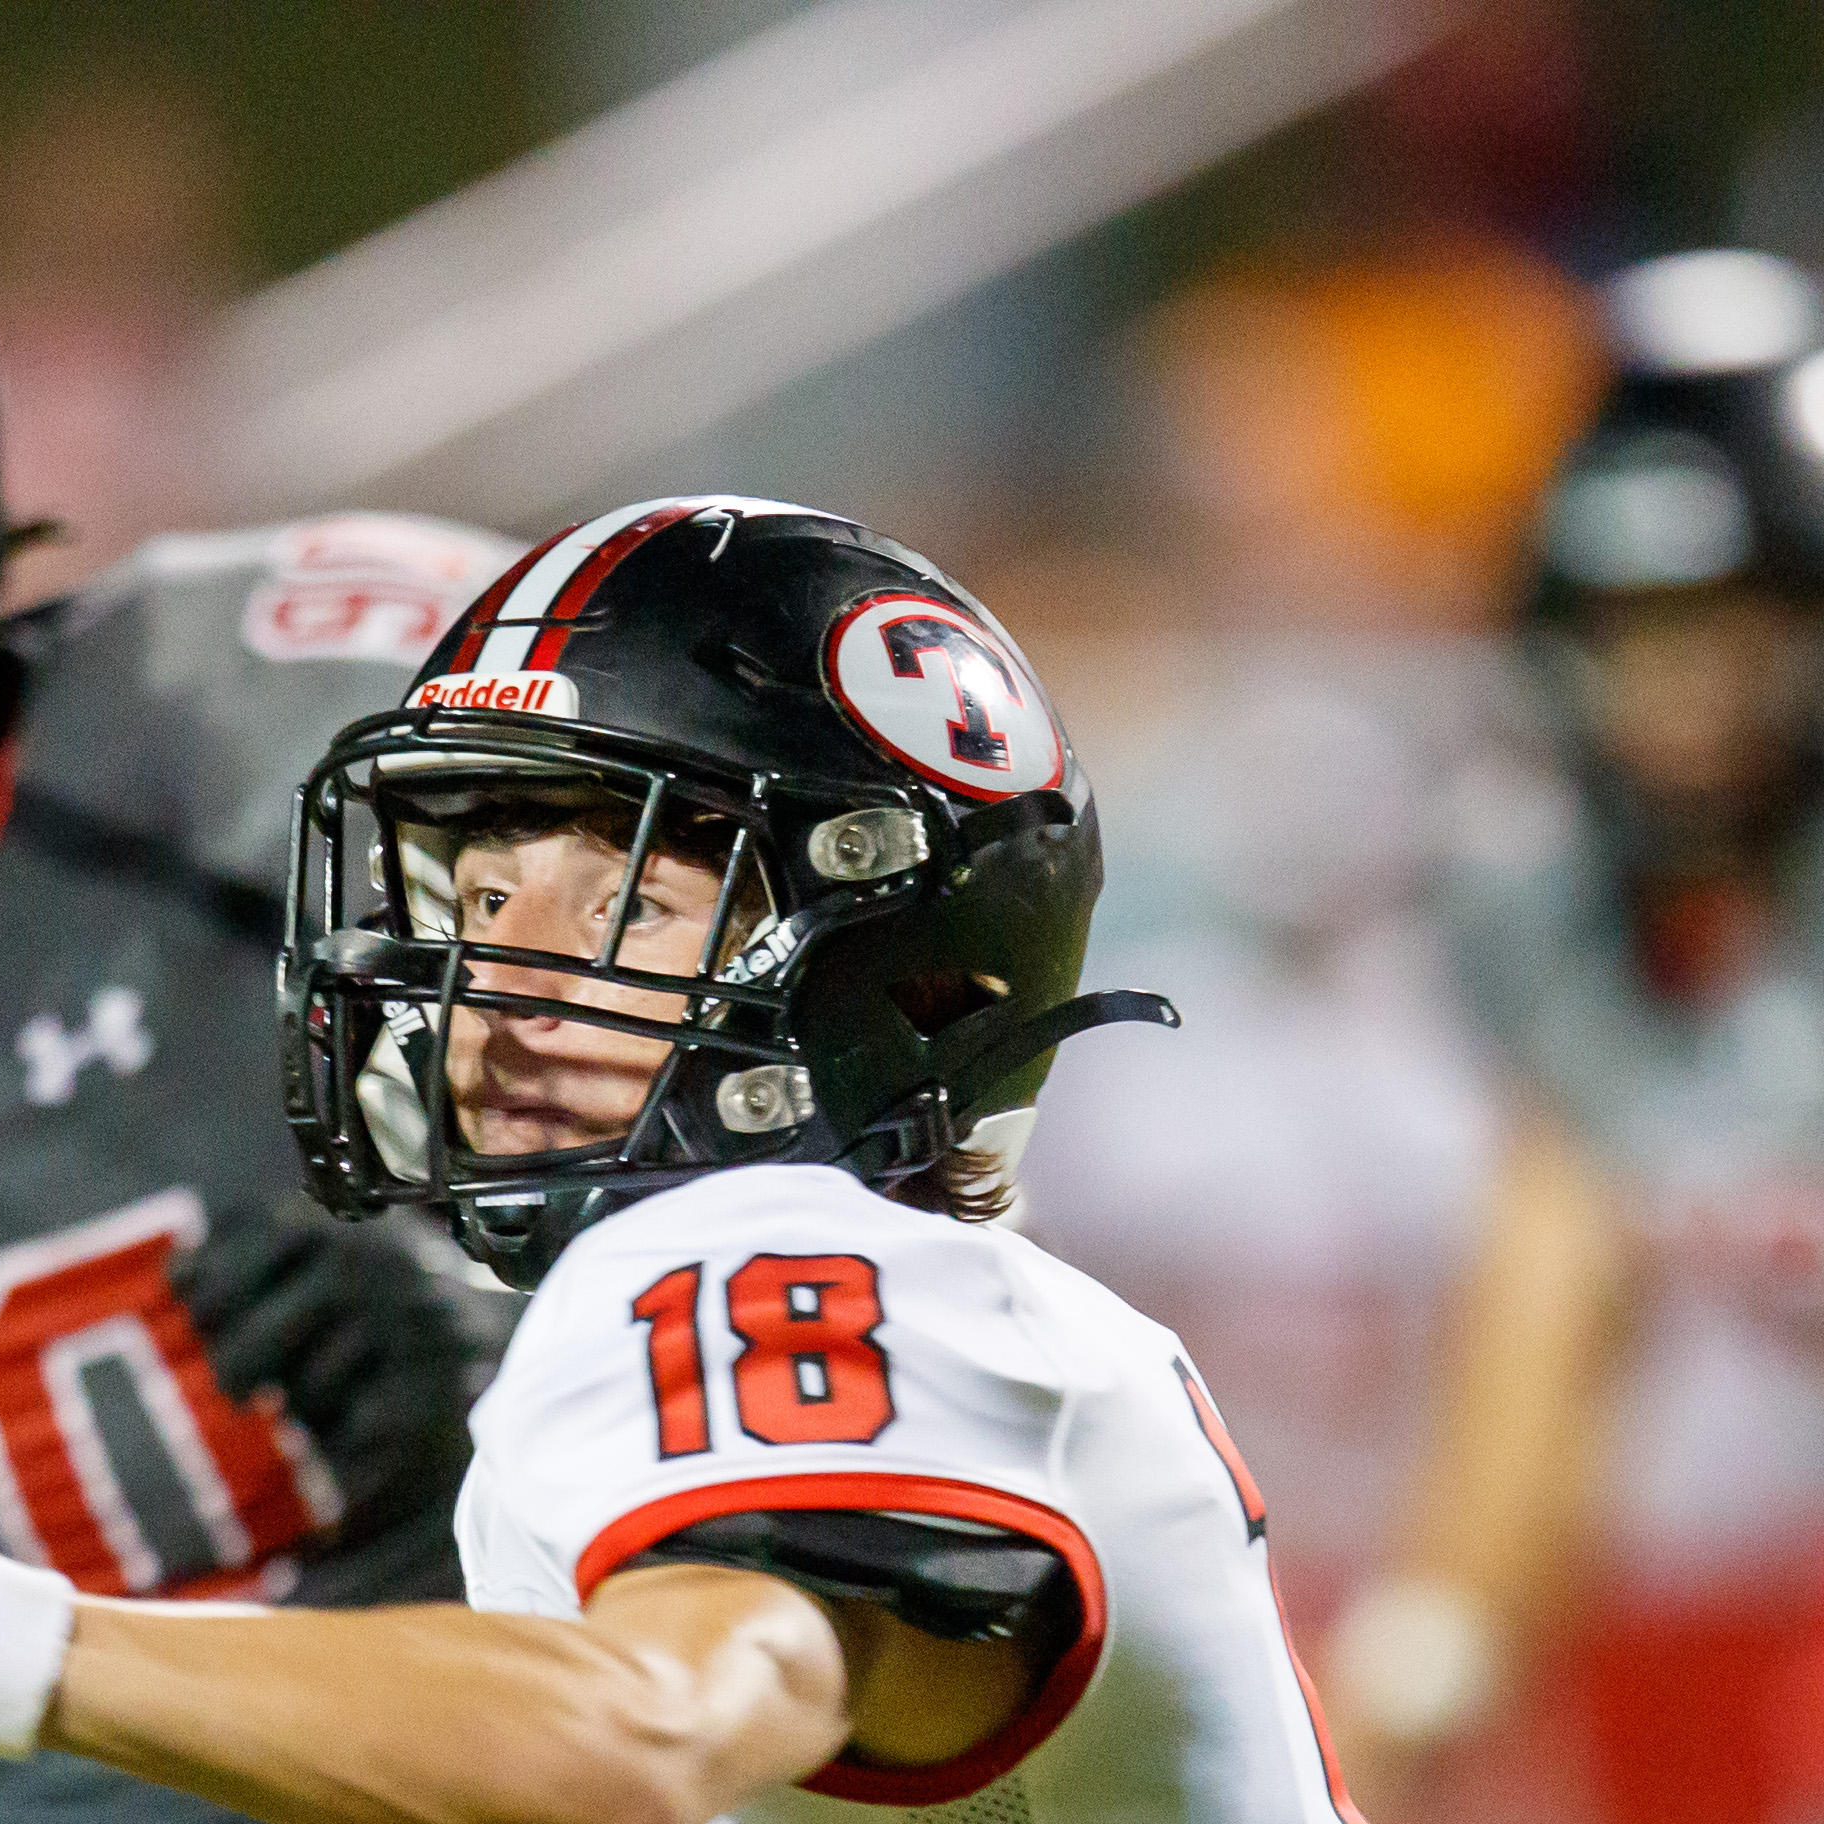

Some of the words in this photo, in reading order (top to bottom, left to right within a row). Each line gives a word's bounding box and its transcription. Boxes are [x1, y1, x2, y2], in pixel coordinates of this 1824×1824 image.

[417, 678, 555, 711] Riddell
[878, 613, 1025, 773] T
[631, 1252, 898, 1462] 18
